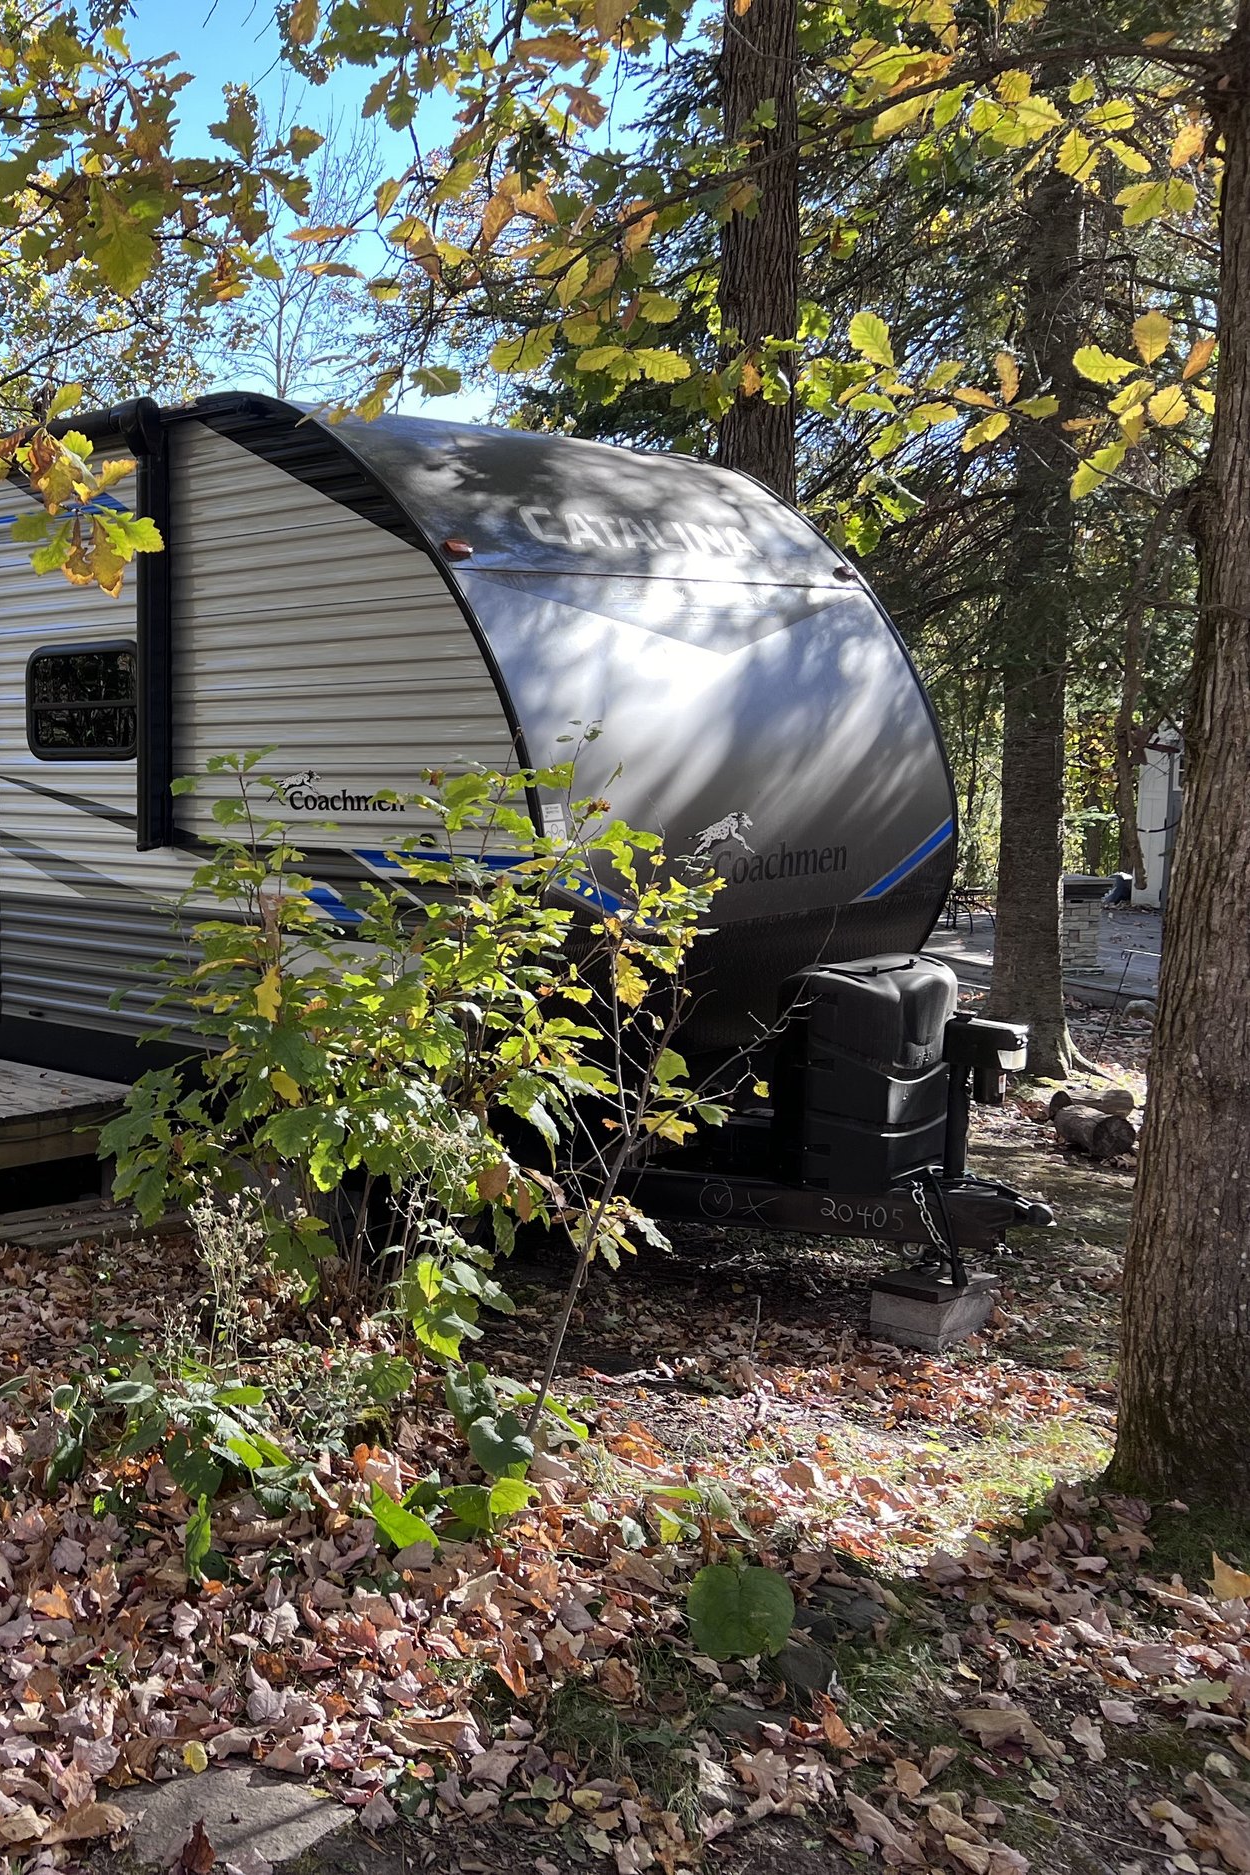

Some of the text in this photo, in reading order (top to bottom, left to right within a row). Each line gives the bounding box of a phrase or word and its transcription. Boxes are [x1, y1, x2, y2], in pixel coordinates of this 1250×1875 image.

[518, 505, 763, 557] CATALINA
[714, 841, 847, 884] Coachmen
[820, 1197, 904, 1231] 20405
